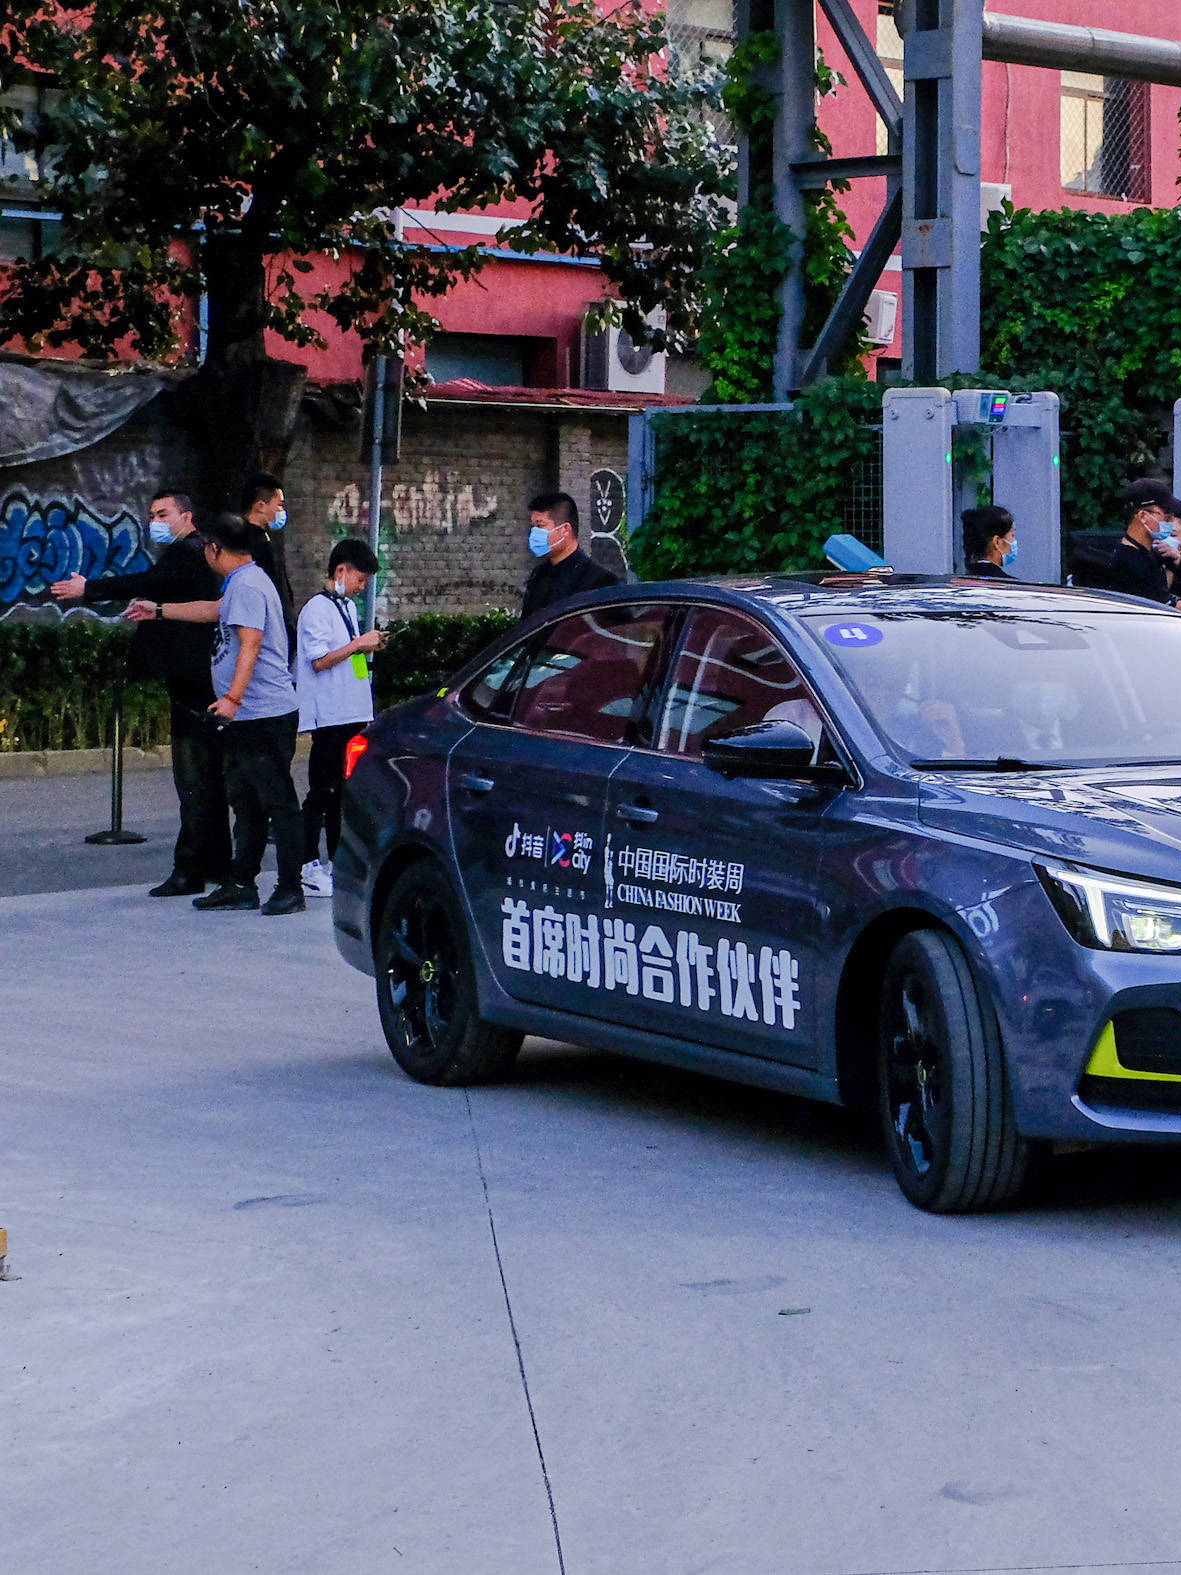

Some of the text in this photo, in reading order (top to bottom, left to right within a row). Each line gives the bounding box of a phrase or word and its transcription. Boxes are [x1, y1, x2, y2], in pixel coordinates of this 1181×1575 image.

[520, 832, 545, 859] 抖音
[616, 883, 654, 908] CHINA
[655, 889, 703, 916] FASHION
[704, 898, 742, 924] WEEK
[500, 897, 801, 1030] 首席时尚合作伙伴
